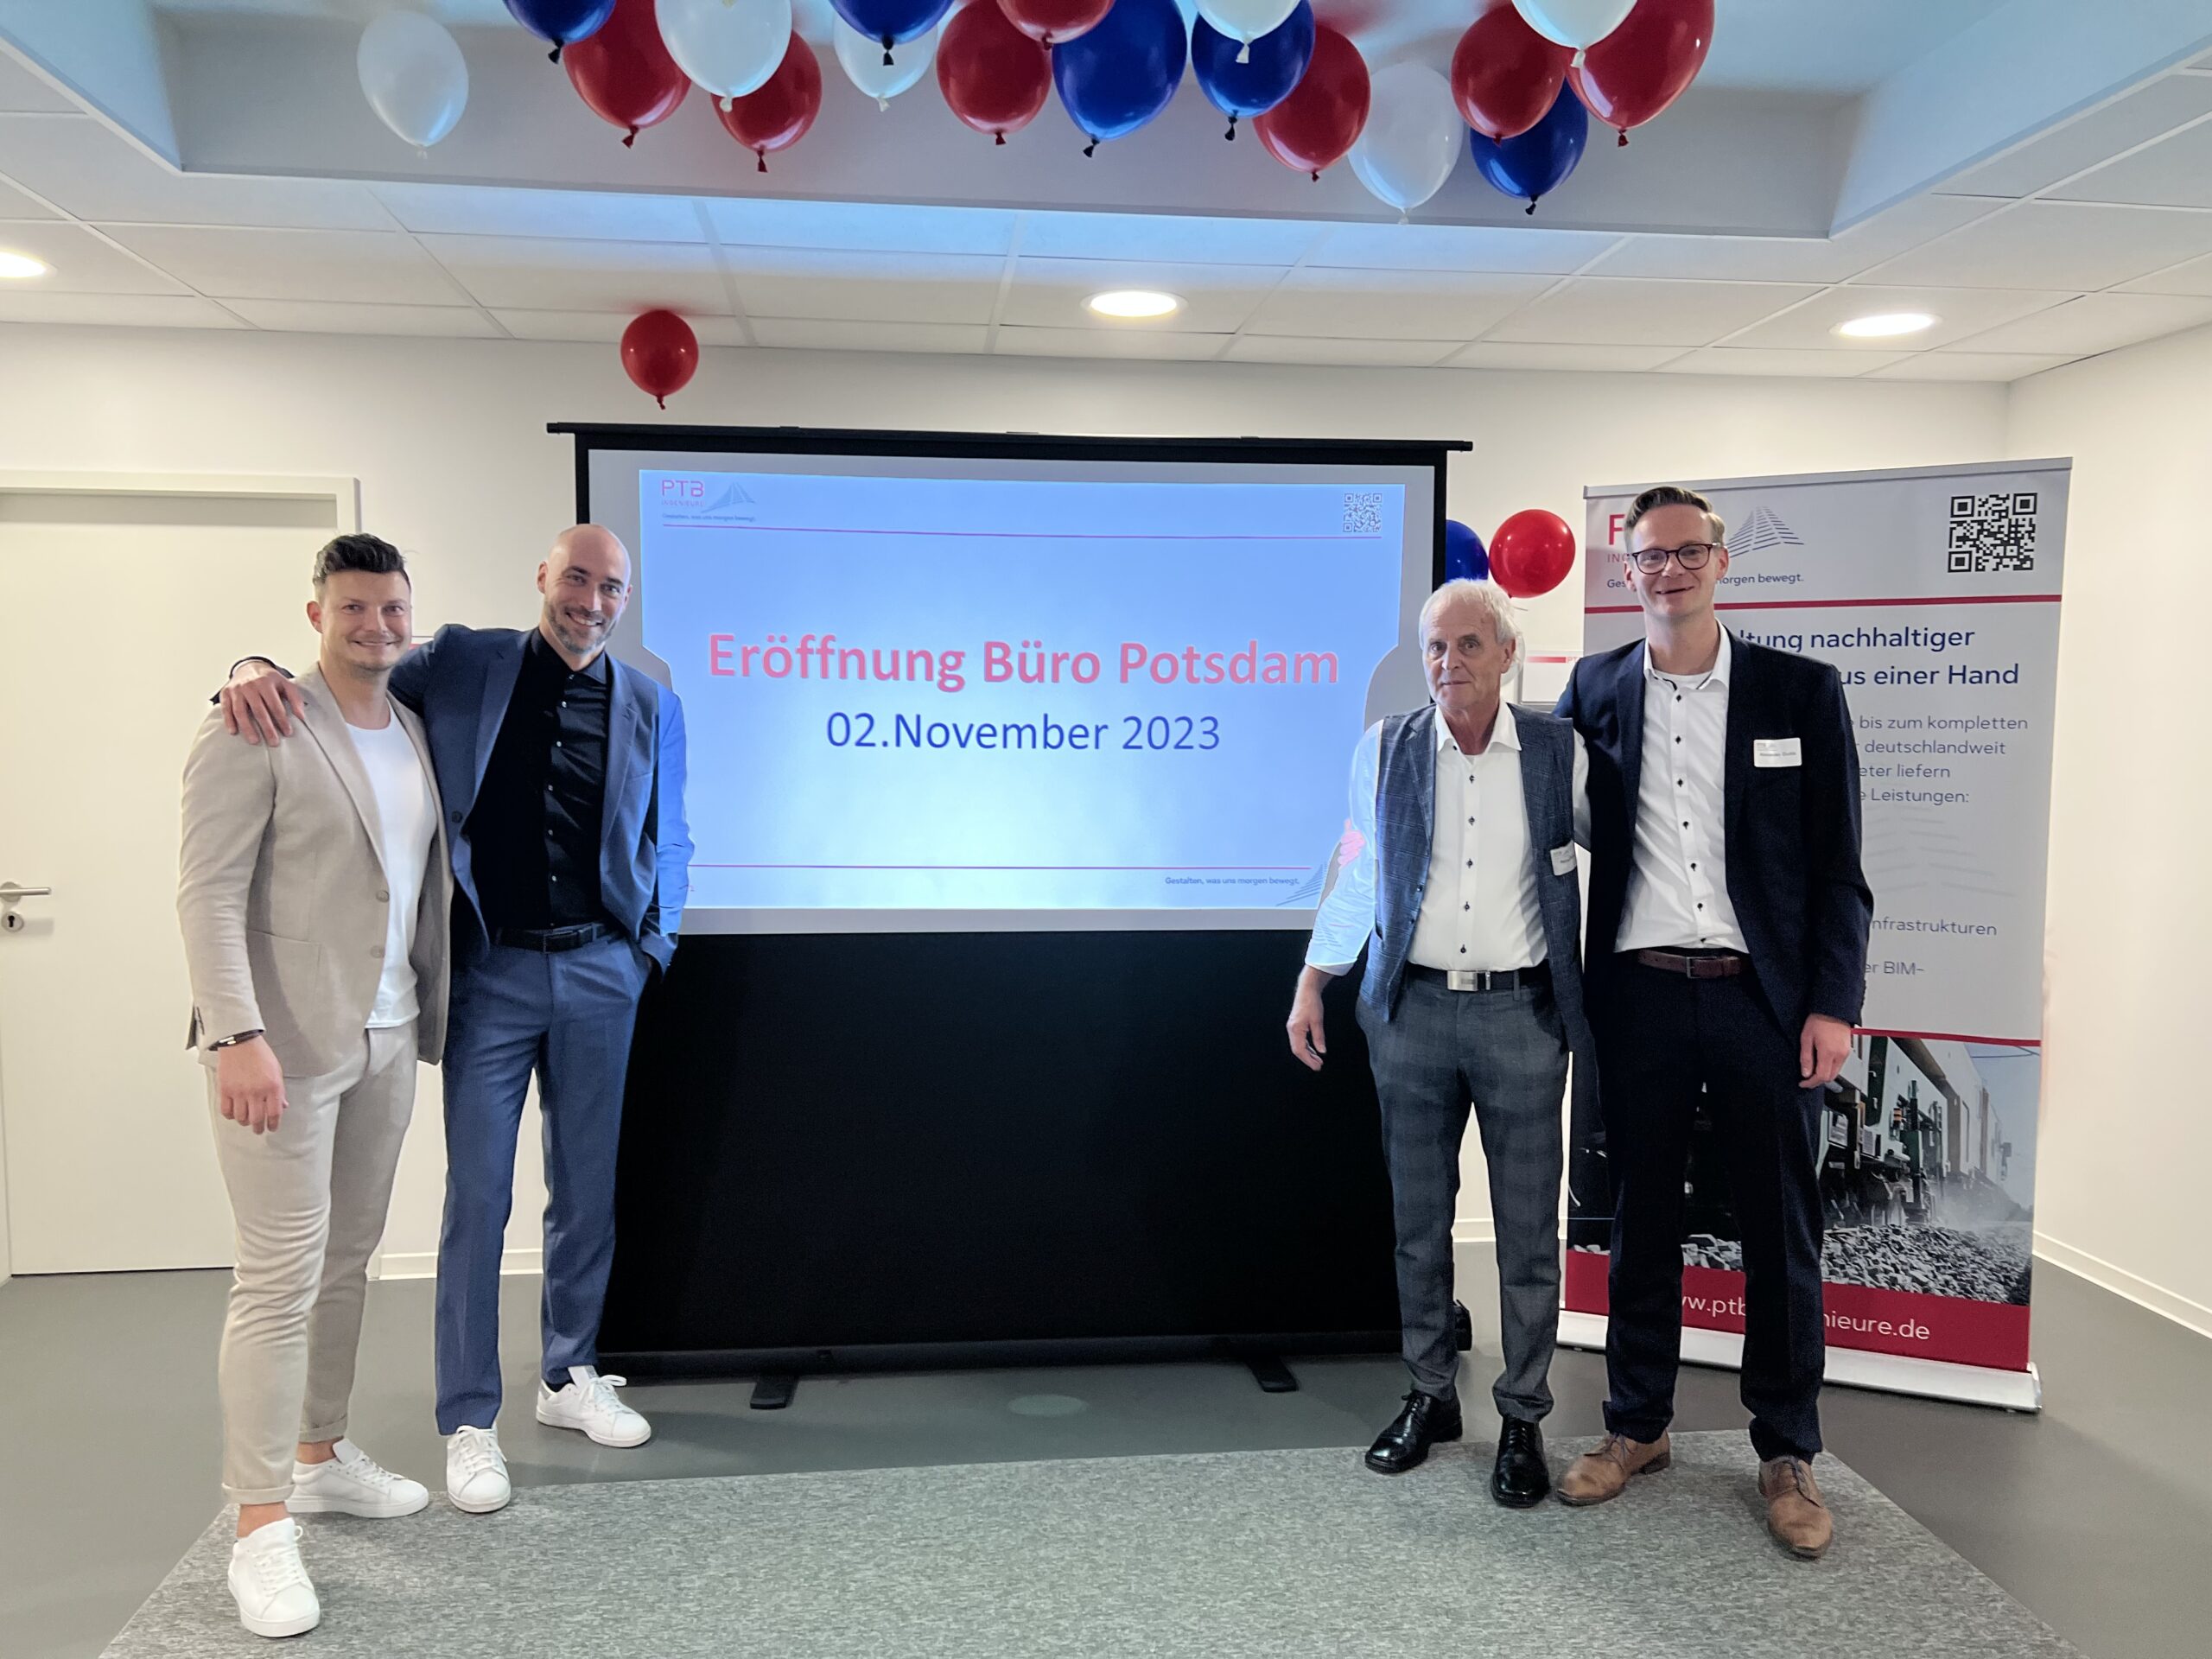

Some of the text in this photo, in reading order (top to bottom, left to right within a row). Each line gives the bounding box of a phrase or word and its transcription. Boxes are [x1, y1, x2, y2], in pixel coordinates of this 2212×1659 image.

[662, 480, 704, 498] PTB
[1715, 576, 1755, 586] orgen
[1758, 573, 1804, 585] bewegt.
[1810, 626, 1975, 652] nachhaltiger
[709, 633, 1338, 693] Eröffnung Büro Potsdam
[1873, 665, 1940, 685] einer
[1948, 663, 2019, 685] Hand
[826, 711, 1221, 751] 02.November 2023
[1859, 715, 1882, 729] bis
[1887, 718, 1923, 729] zum
[1928, 715, 2029, 734] kompletten
[1865, 740, 2006, 755] deutschlandweit
[1897, 764, 1951, 779] liefern
[1871, 788, 1970, 806] Leistungen:
[1237, 878, 1268, 887] morgen
[1883, 960, 1924, 976] BIM-
[1681, 1296, 1746, 1318] w.ptb
